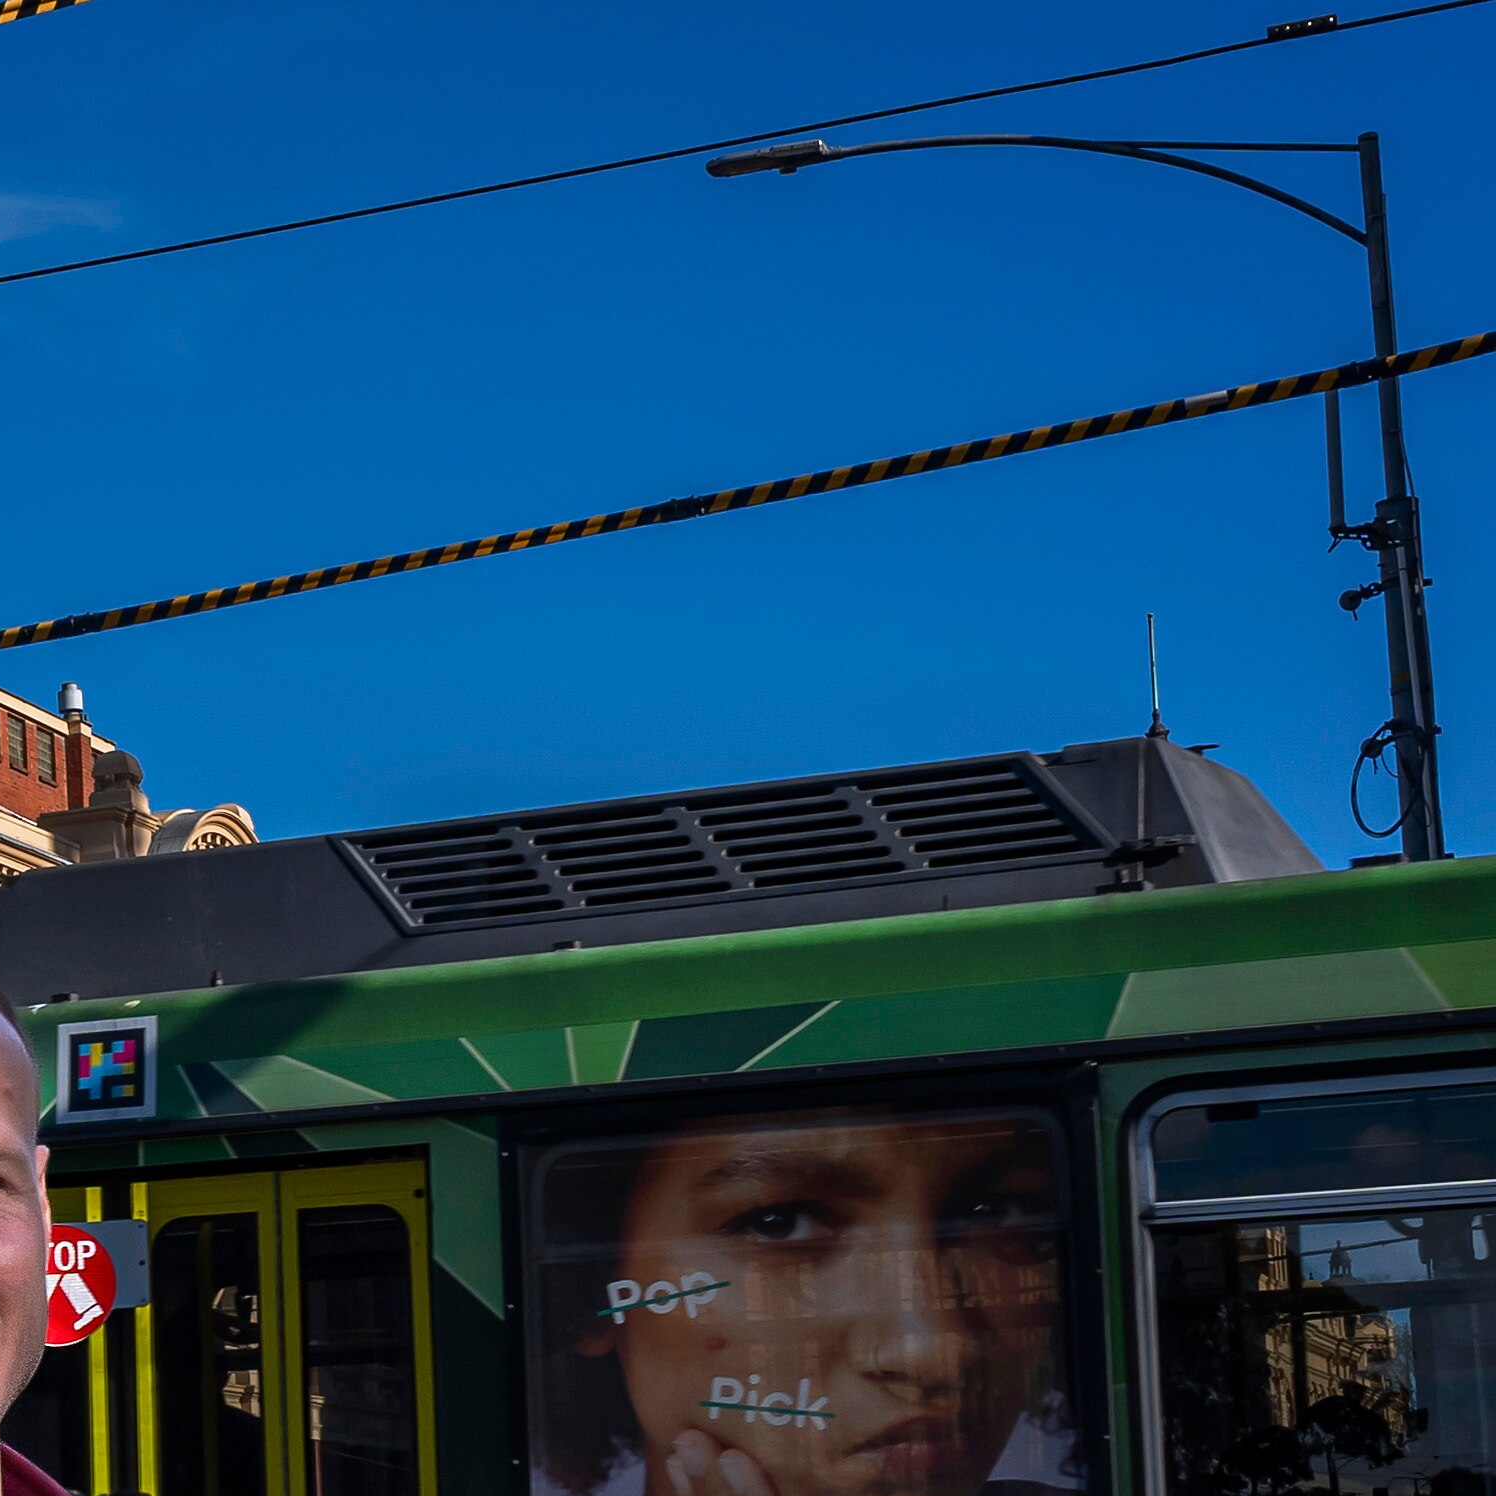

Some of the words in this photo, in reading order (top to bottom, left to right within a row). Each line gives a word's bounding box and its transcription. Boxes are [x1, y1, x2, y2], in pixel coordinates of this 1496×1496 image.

[48, 1240, 96, 1271] OP
[607, 1272, 718, 1324] Pop
[708, 1374, 829, 1430] Pick
